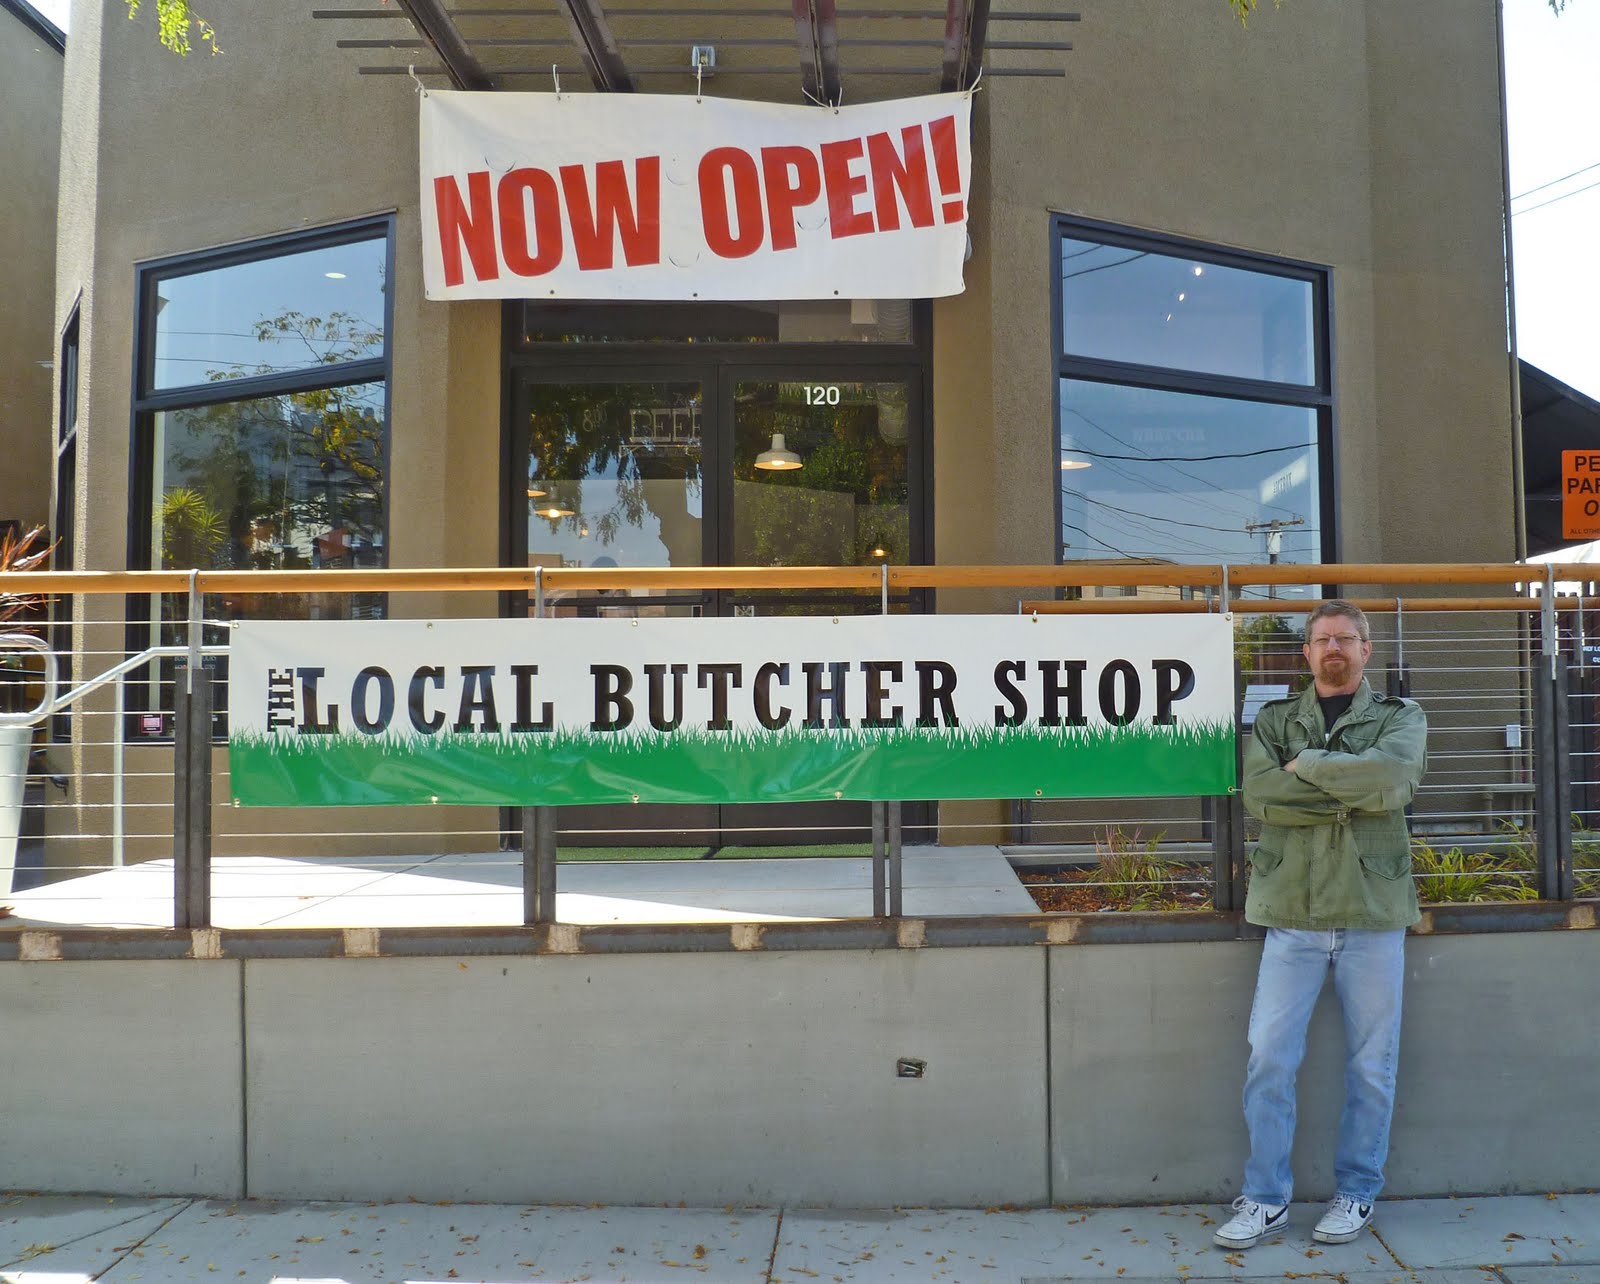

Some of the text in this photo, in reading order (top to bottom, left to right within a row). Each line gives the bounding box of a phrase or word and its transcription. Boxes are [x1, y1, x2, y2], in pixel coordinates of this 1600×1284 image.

[434, 115, 964, 287] NOW OPEN!
[803, 386, 840, 405] 120
[267, 669, 294, 732] THE
[297, 659, 1195, 734] LOCAL BUTCHER SHOP
